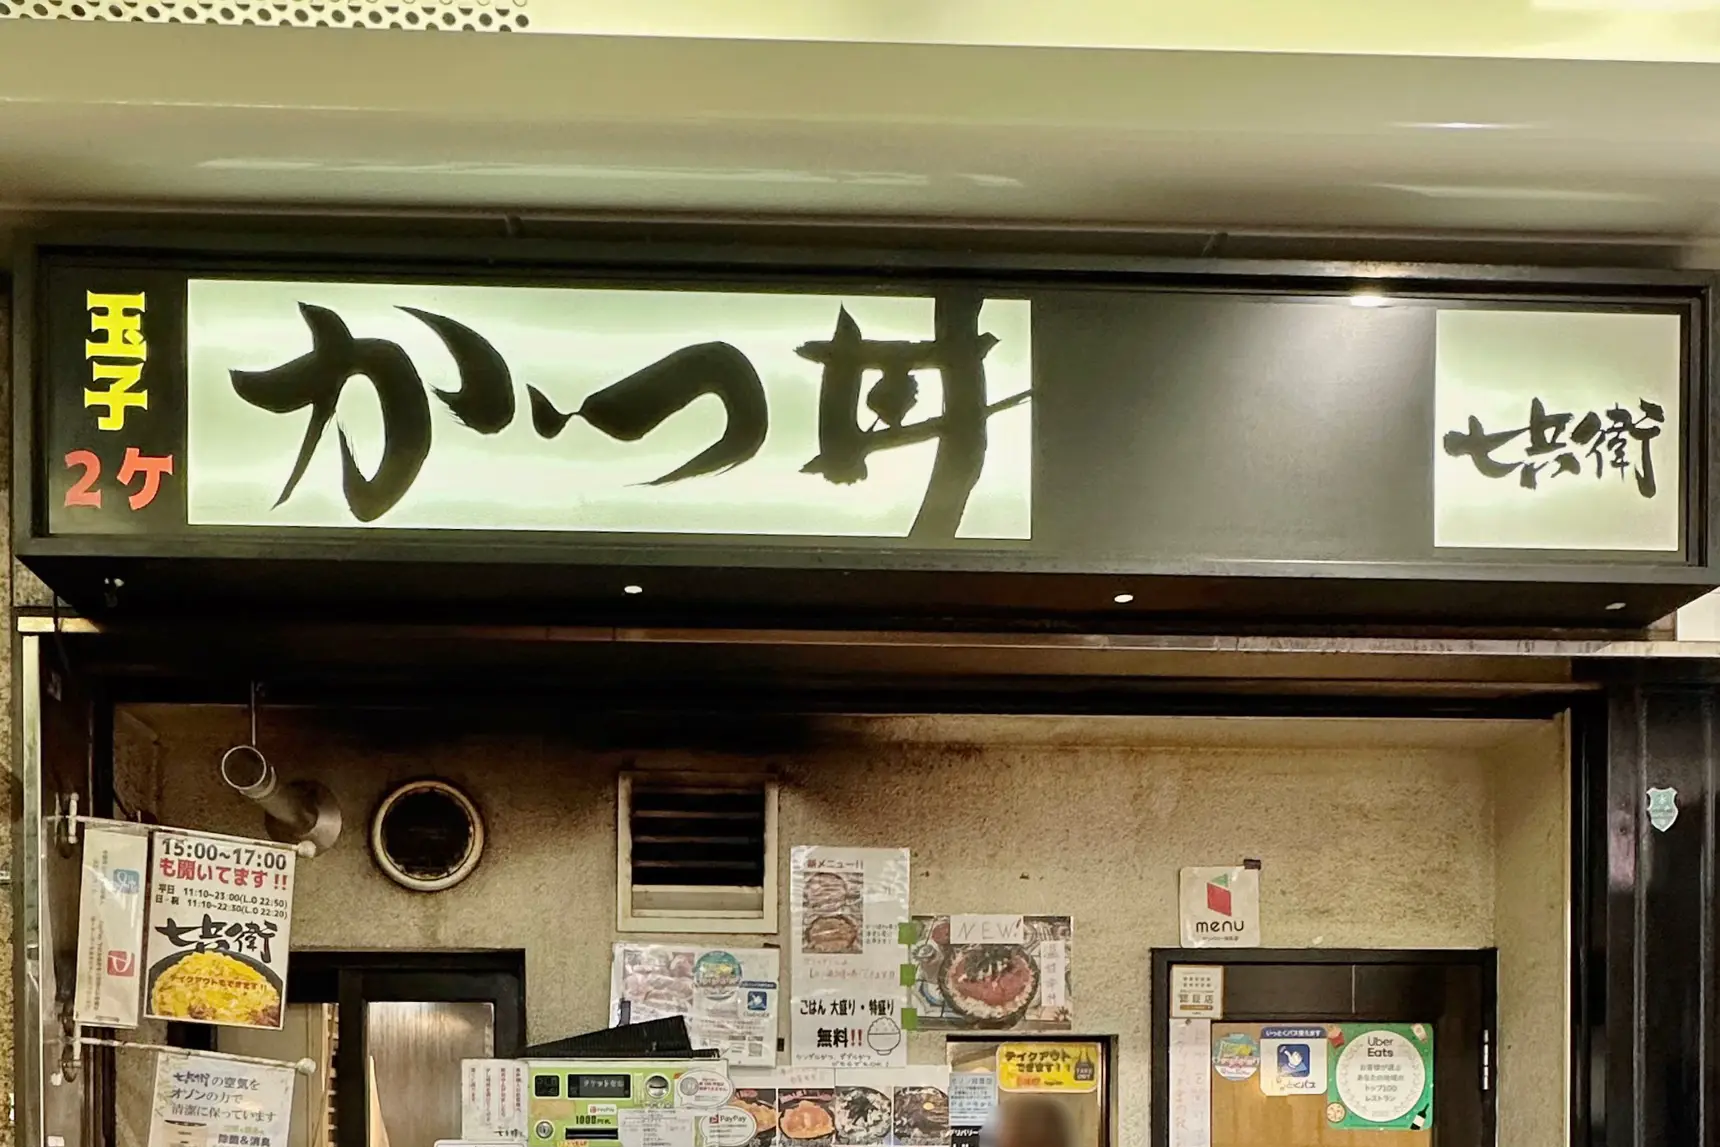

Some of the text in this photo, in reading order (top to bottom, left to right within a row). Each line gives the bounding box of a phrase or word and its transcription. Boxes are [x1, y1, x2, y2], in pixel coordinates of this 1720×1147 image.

[84, 289, 148, 431] 玉子
[1442, 396, 1665, 498] 七兵衛
[63, 447, 174, 511] 2ケ
[155, 913, 278, 963] 七兵衛
[1196, 920, 1244, 933] menu
[1004, 1050, 1071, 1062] テイクアウト
[1367, 1036, 1394, 1046] Uber
[1367, 1048, 1394, 1058] Eats
